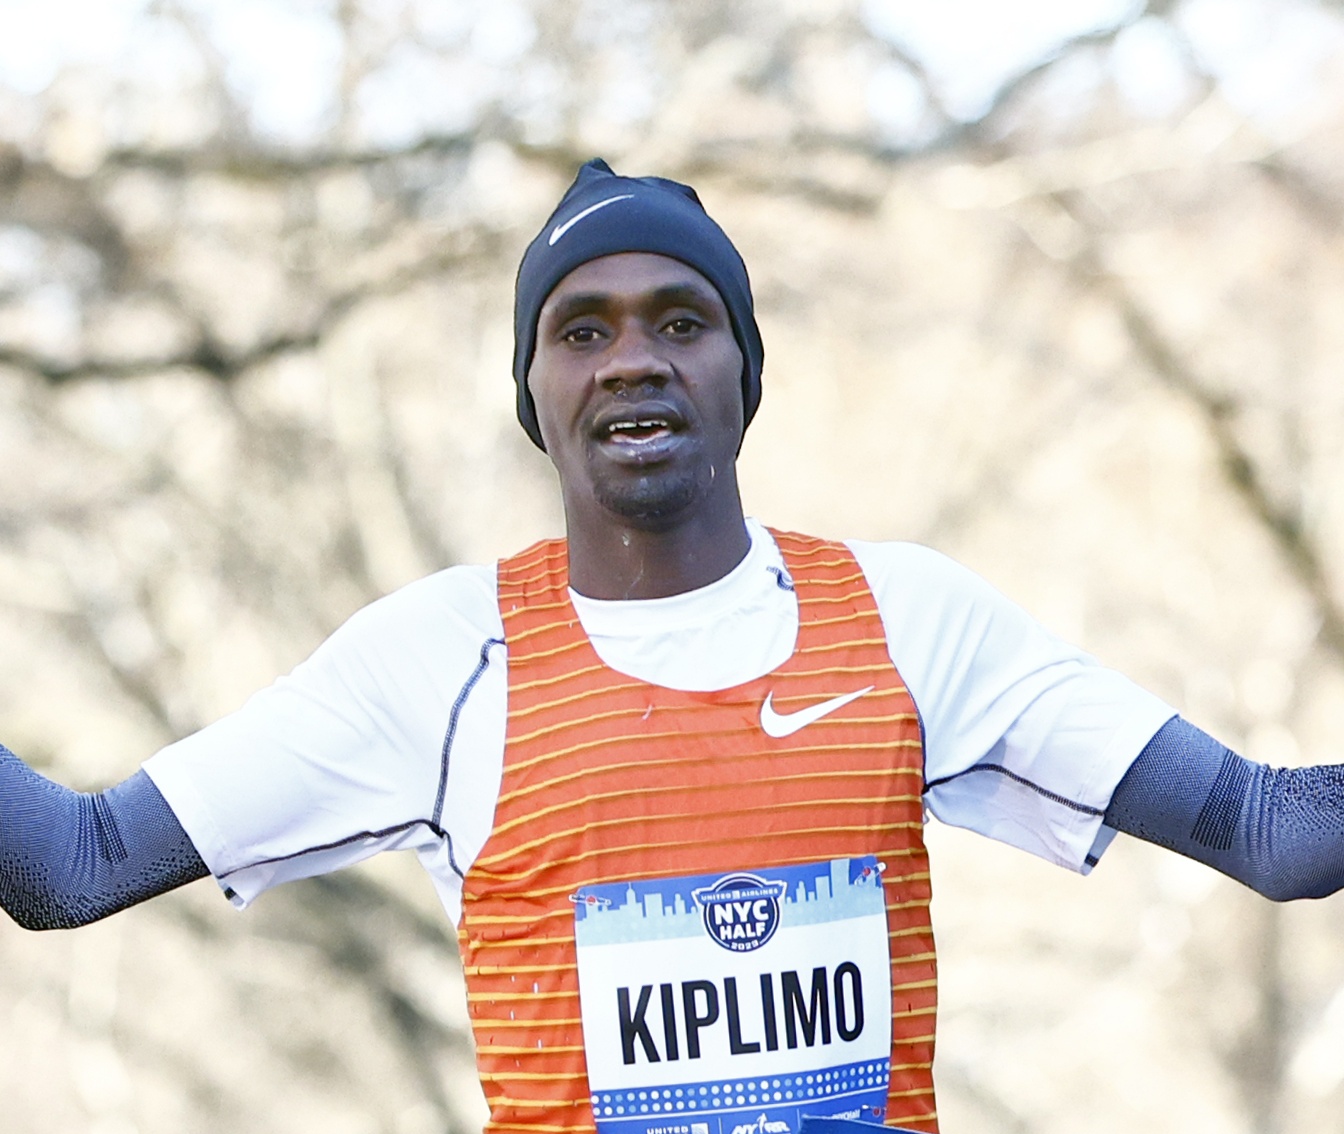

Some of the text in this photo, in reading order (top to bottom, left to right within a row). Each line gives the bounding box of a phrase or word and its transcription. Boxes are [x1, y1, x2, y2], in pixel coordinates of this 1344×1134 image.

[701, 893, 731, 901] UNITED
[714, 899, 769, 925] NYC
[720, 922, 765, 940] HALF
[616, 961, 865, 1065] KIPLIMO
